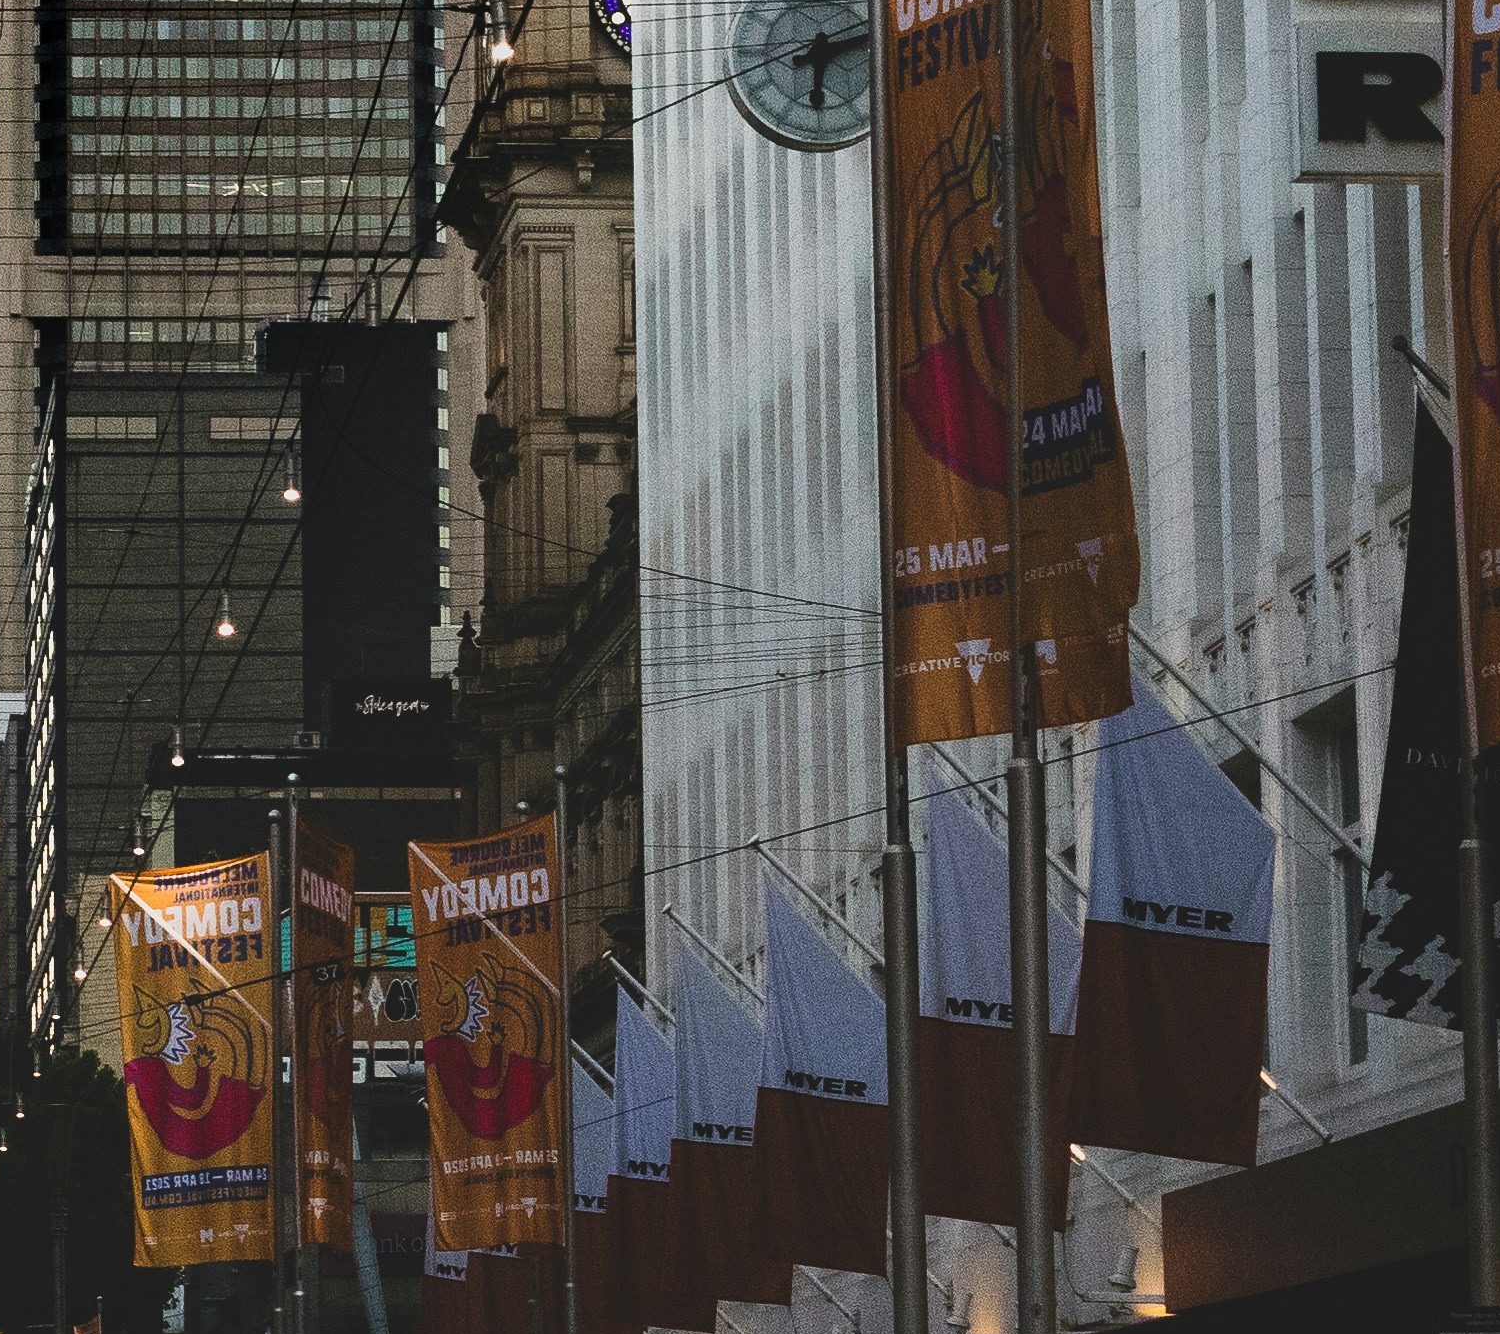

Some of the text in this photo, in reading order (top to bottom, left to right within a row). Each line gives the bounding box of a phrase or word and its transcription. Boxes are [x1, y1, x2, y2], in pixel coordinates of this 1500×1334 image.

[898, 2, 993, 92] FESTIV
[895, 536, 988, 578] 25 MAR
[1406, 747, 1463, 774] DAVI
[1122, 897, 1234, 934] MYER
[316, 963, 338, 981] 37
[945, 997, 1014, 1022] MYE
[784, 1070, 868, 1098] MYER
[692, 1121, 753, 1141] MYE
[627, 1160, 668, 1176] MY
